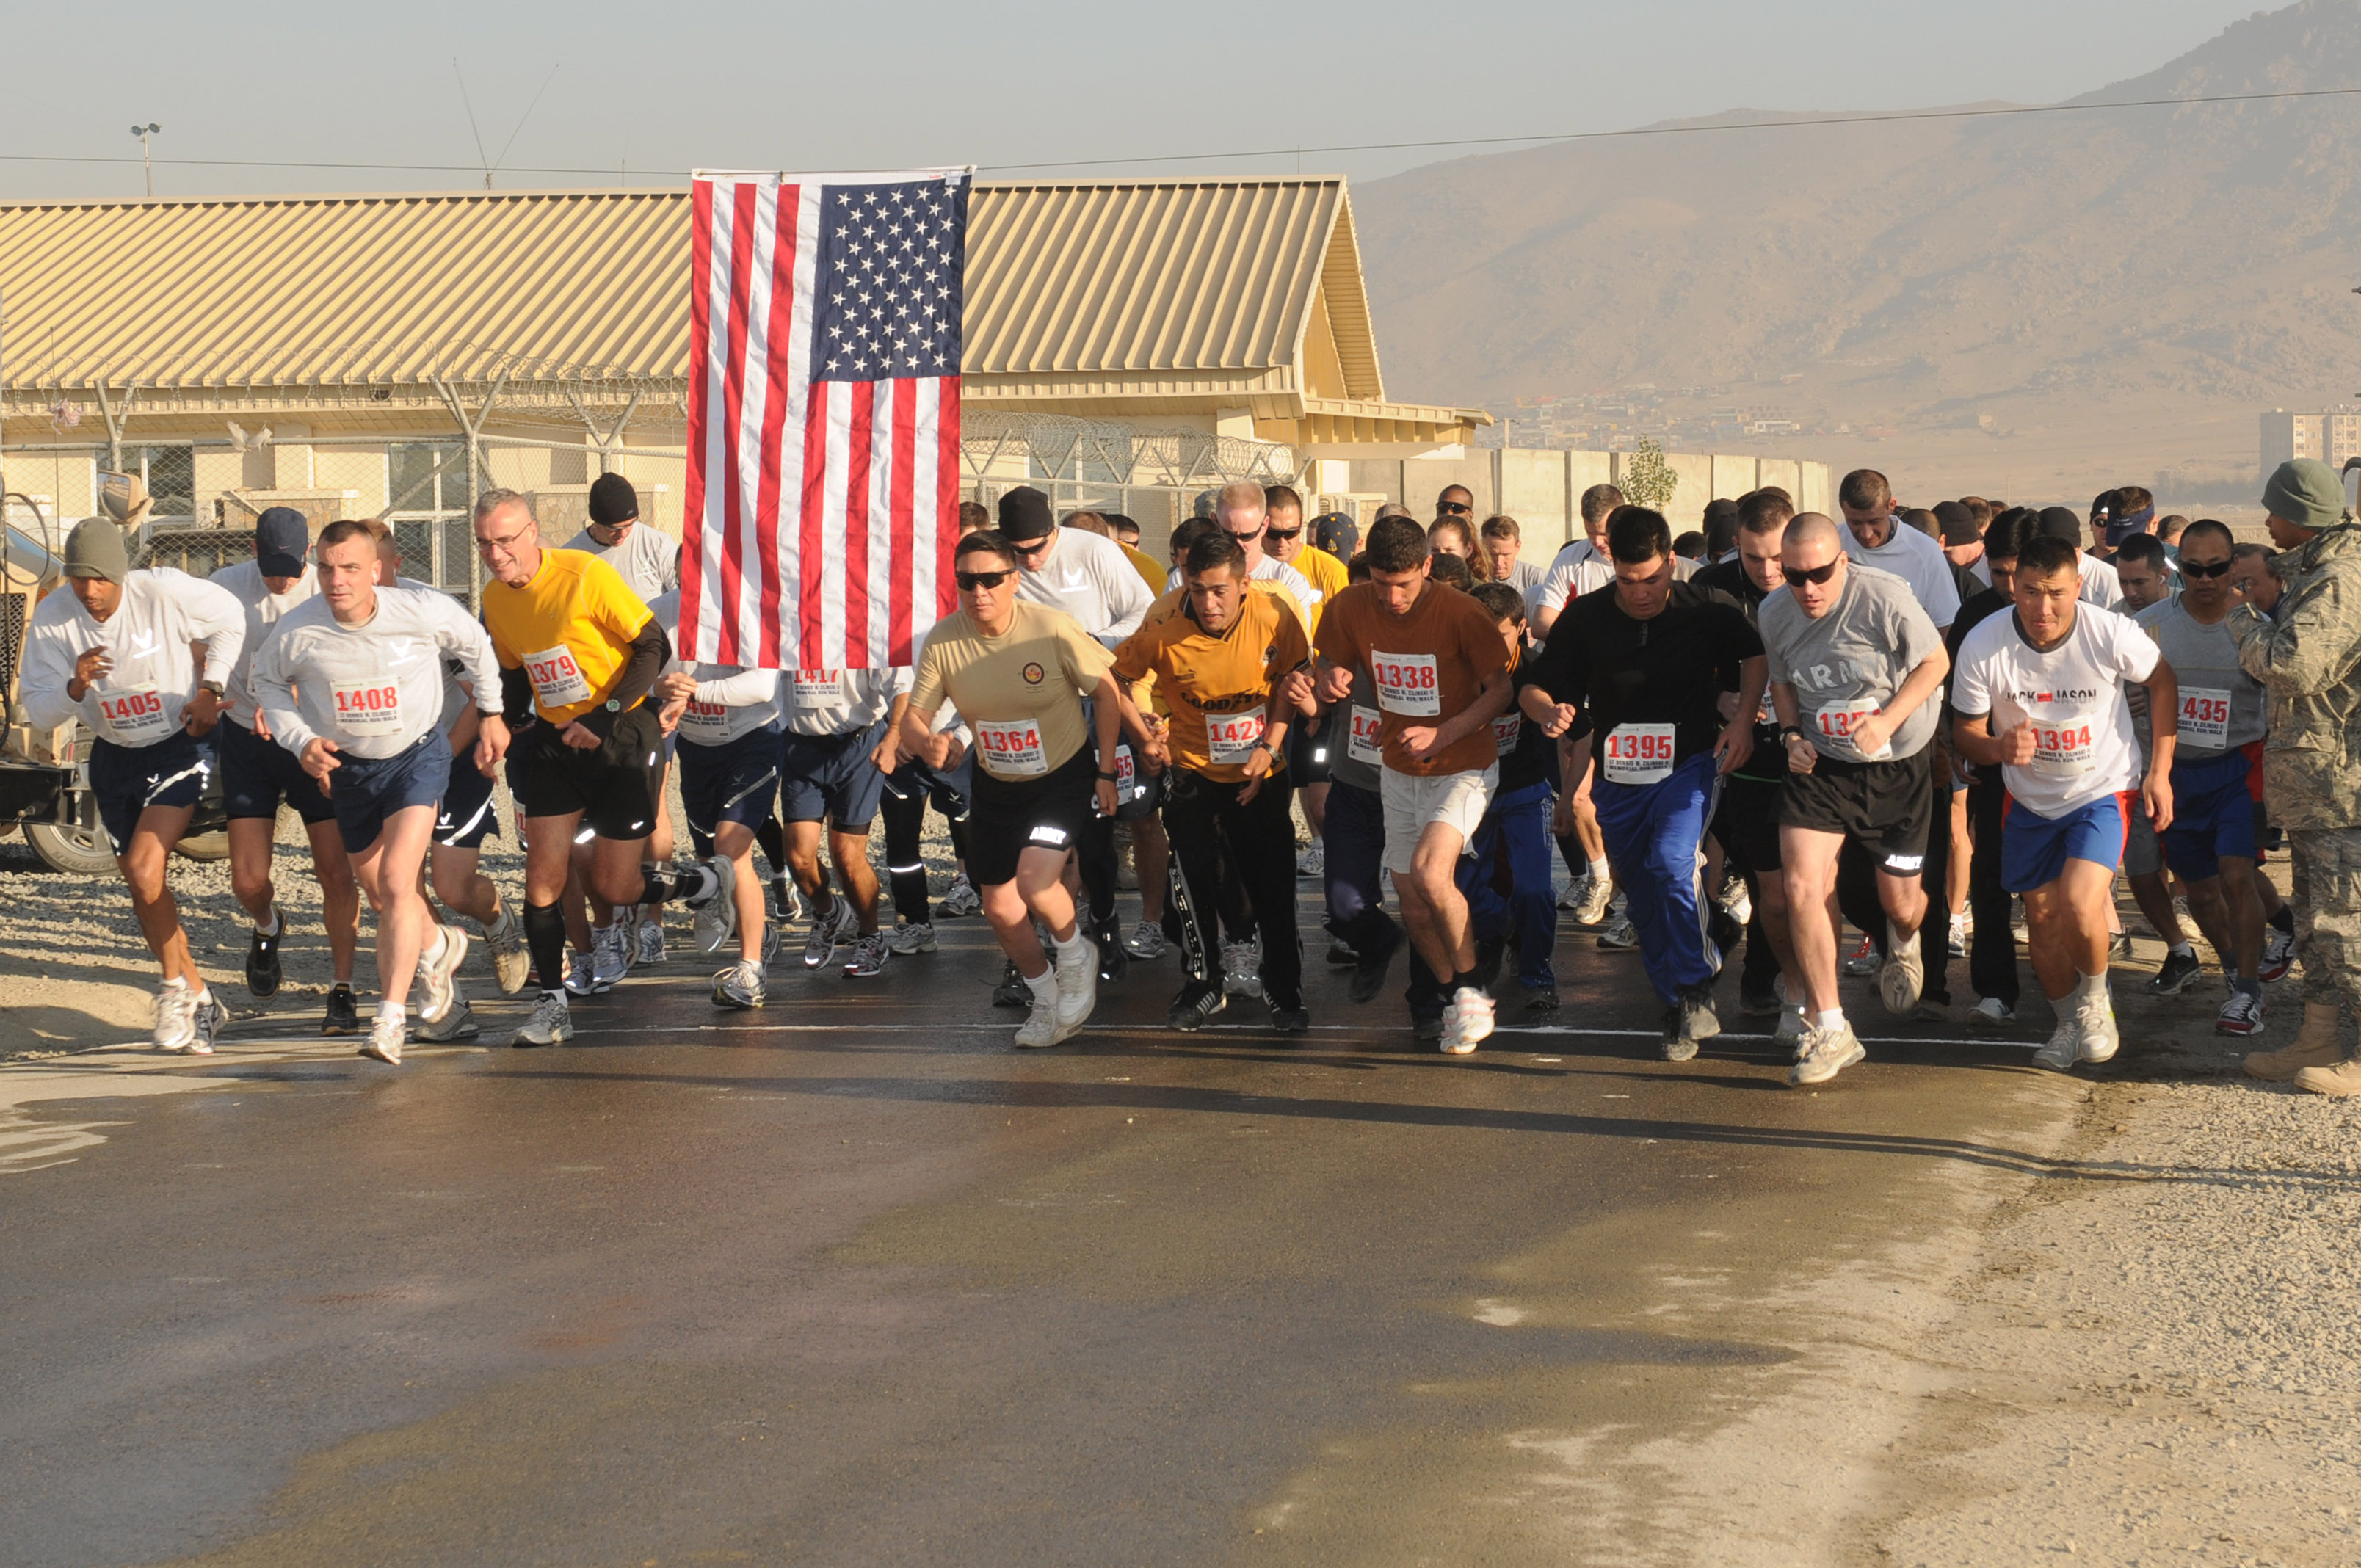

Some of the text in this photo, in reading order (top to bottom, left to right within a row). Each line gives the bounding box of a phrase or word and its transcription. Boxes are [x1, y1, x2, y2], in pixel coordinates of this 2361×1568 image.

[527, 656, 576, 683] 1379
[794, 669, 838, 683] 1417
[1375, 662, 1435, 689] 1338
[1792, 661, 1865, 692] ARM
[101, 691, 161, 719] 1405
[336, 686, 397, 711] 1408
[2006, 691, 2037, 703] JACK
[2054, 689, 2097, 703] JASON
[2183, 697, 2227, 722] 435
[1210, 714, 1265, 741] 1428
[1353, 716, 1379, 736] 14
[1495, 720, 1519, 739] 32
[2031, 725, 2092, 751] 1394
[980, 729, 1040, 752] 1364
[1608, 735, 1672, 759] 1395
[1114, 755, 1133, 778] 65
[1029, 826, 1067, 844] ARMY
[1885, 854, 1923, 870] ARMY
